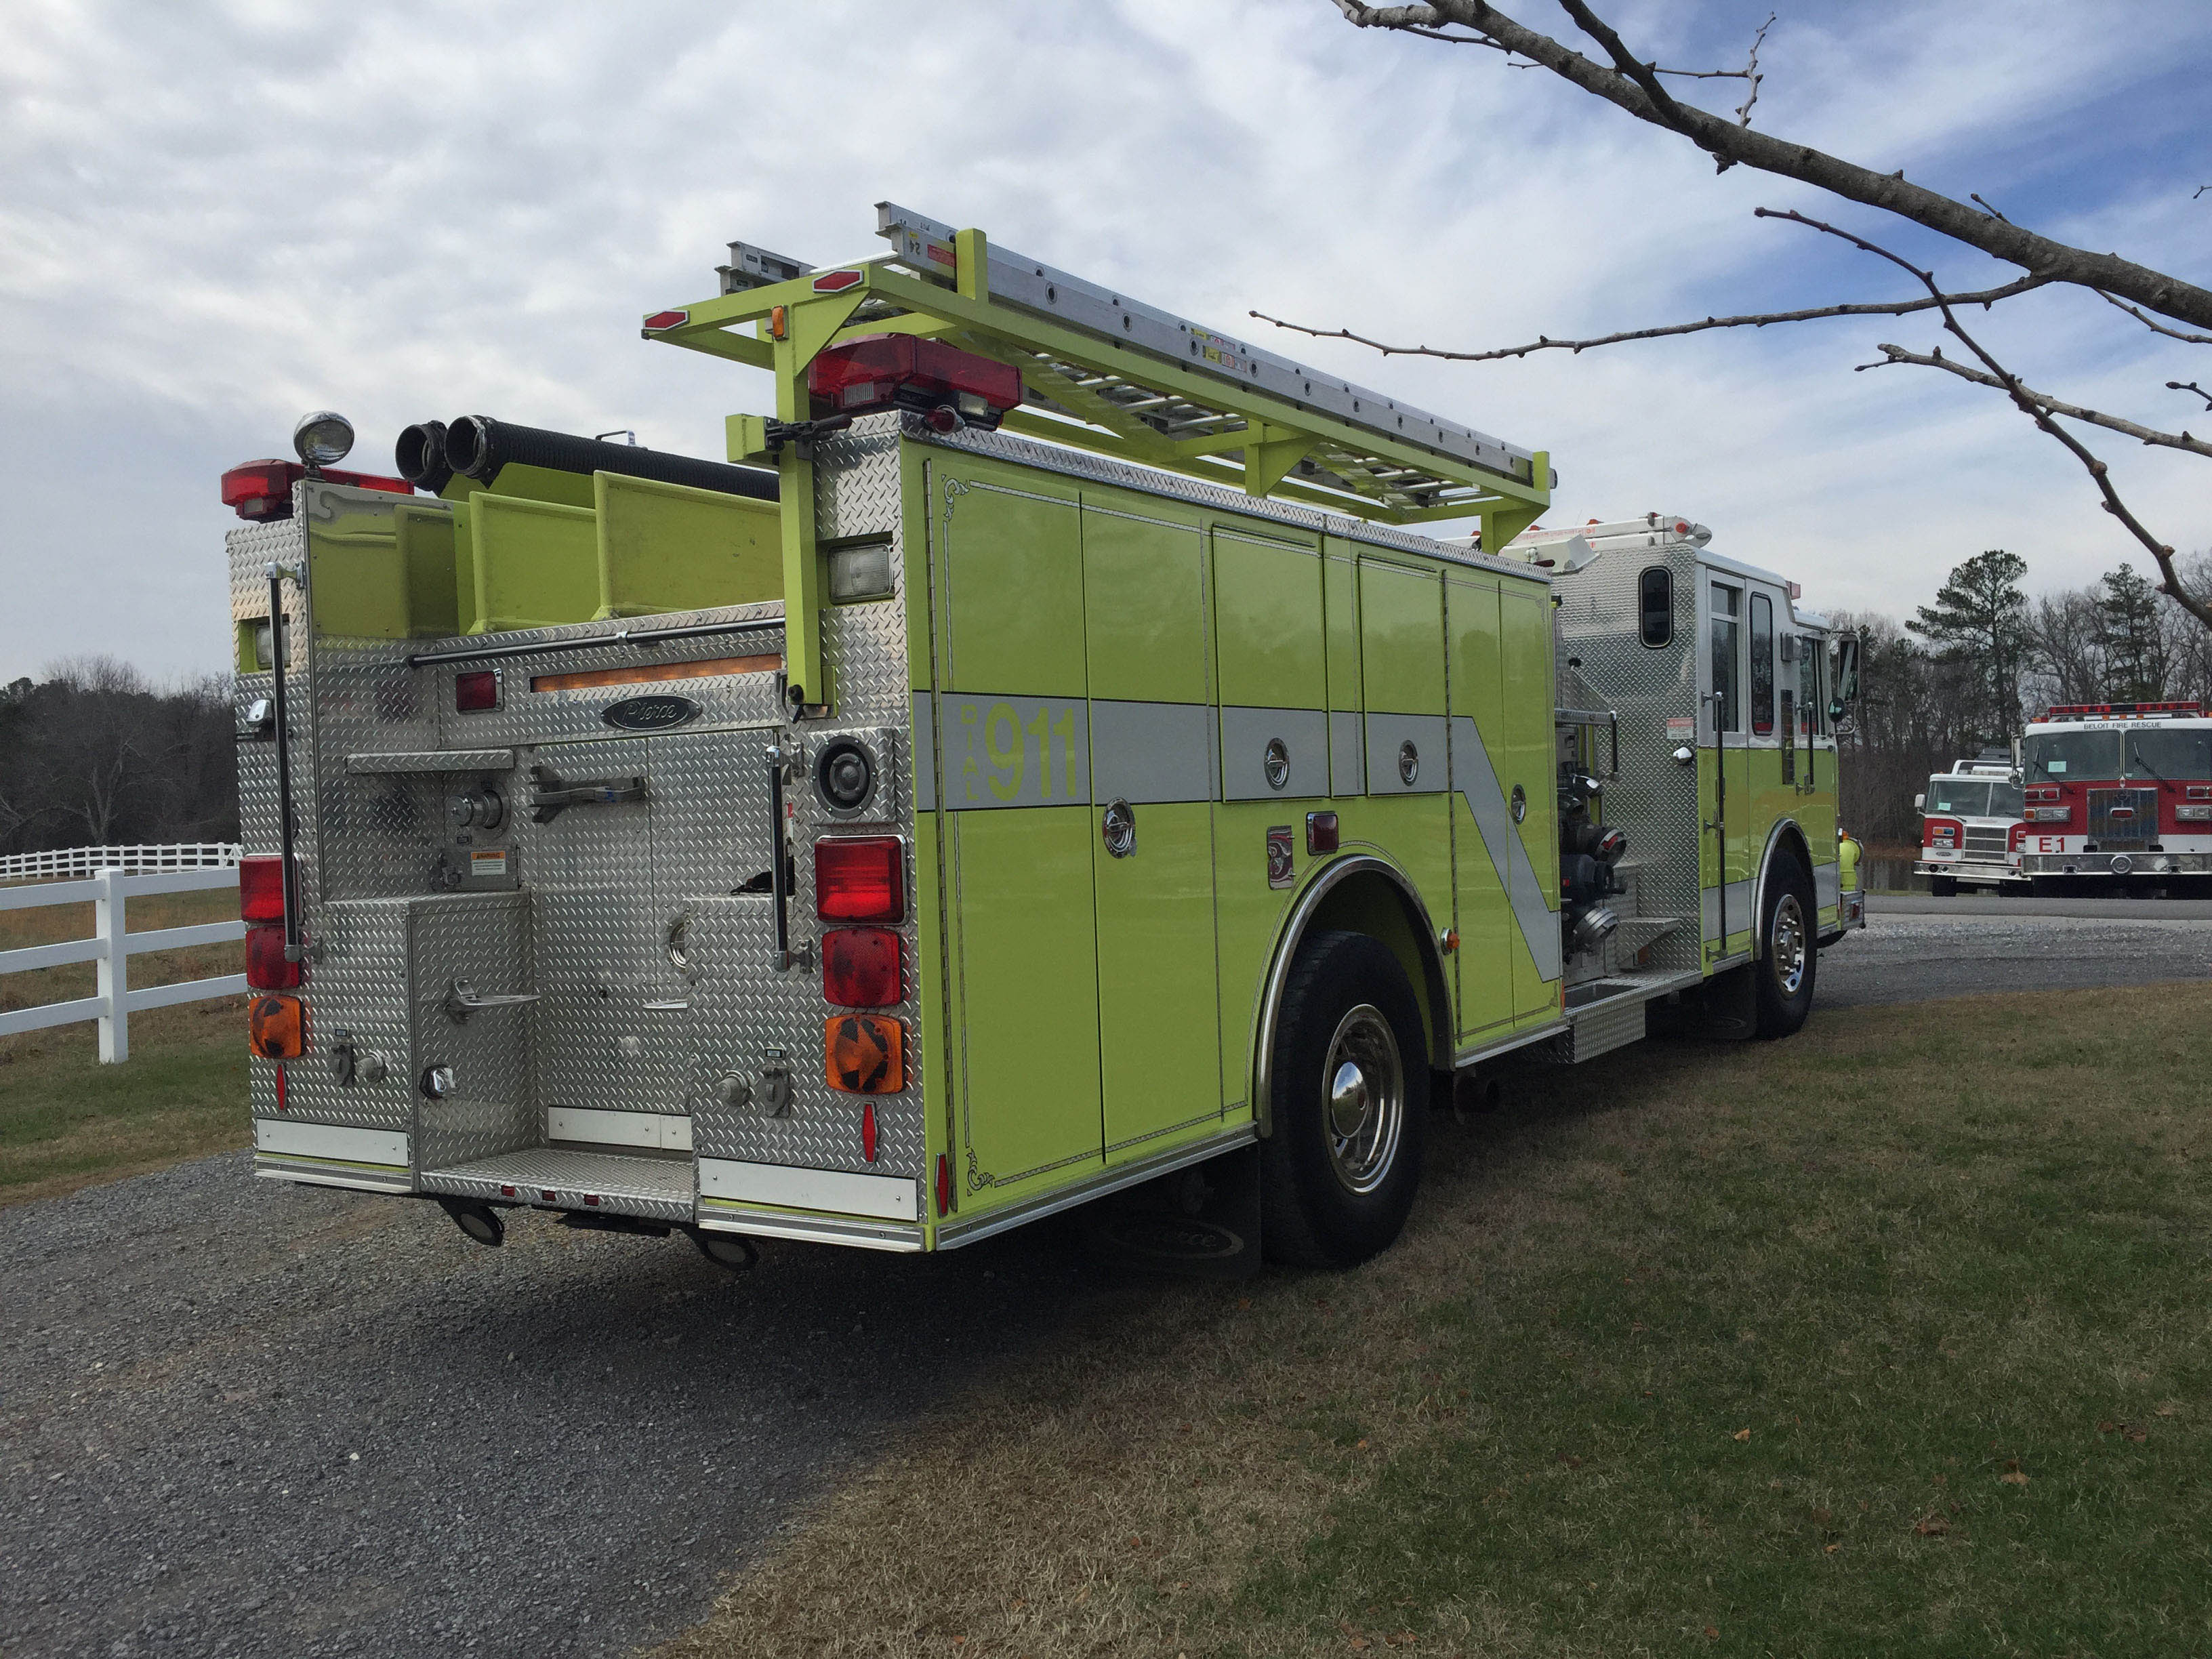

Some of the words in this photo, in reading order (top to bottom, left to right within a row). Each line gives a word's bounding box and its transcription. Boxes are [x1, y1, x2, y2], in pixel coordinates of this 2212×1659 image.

[622, 701, 677, 722] Pierce
[961, 704, 979, 801] DIAL
[985, 702, 1077, 802] 911
[2039, 837, 2065, 853] E1
